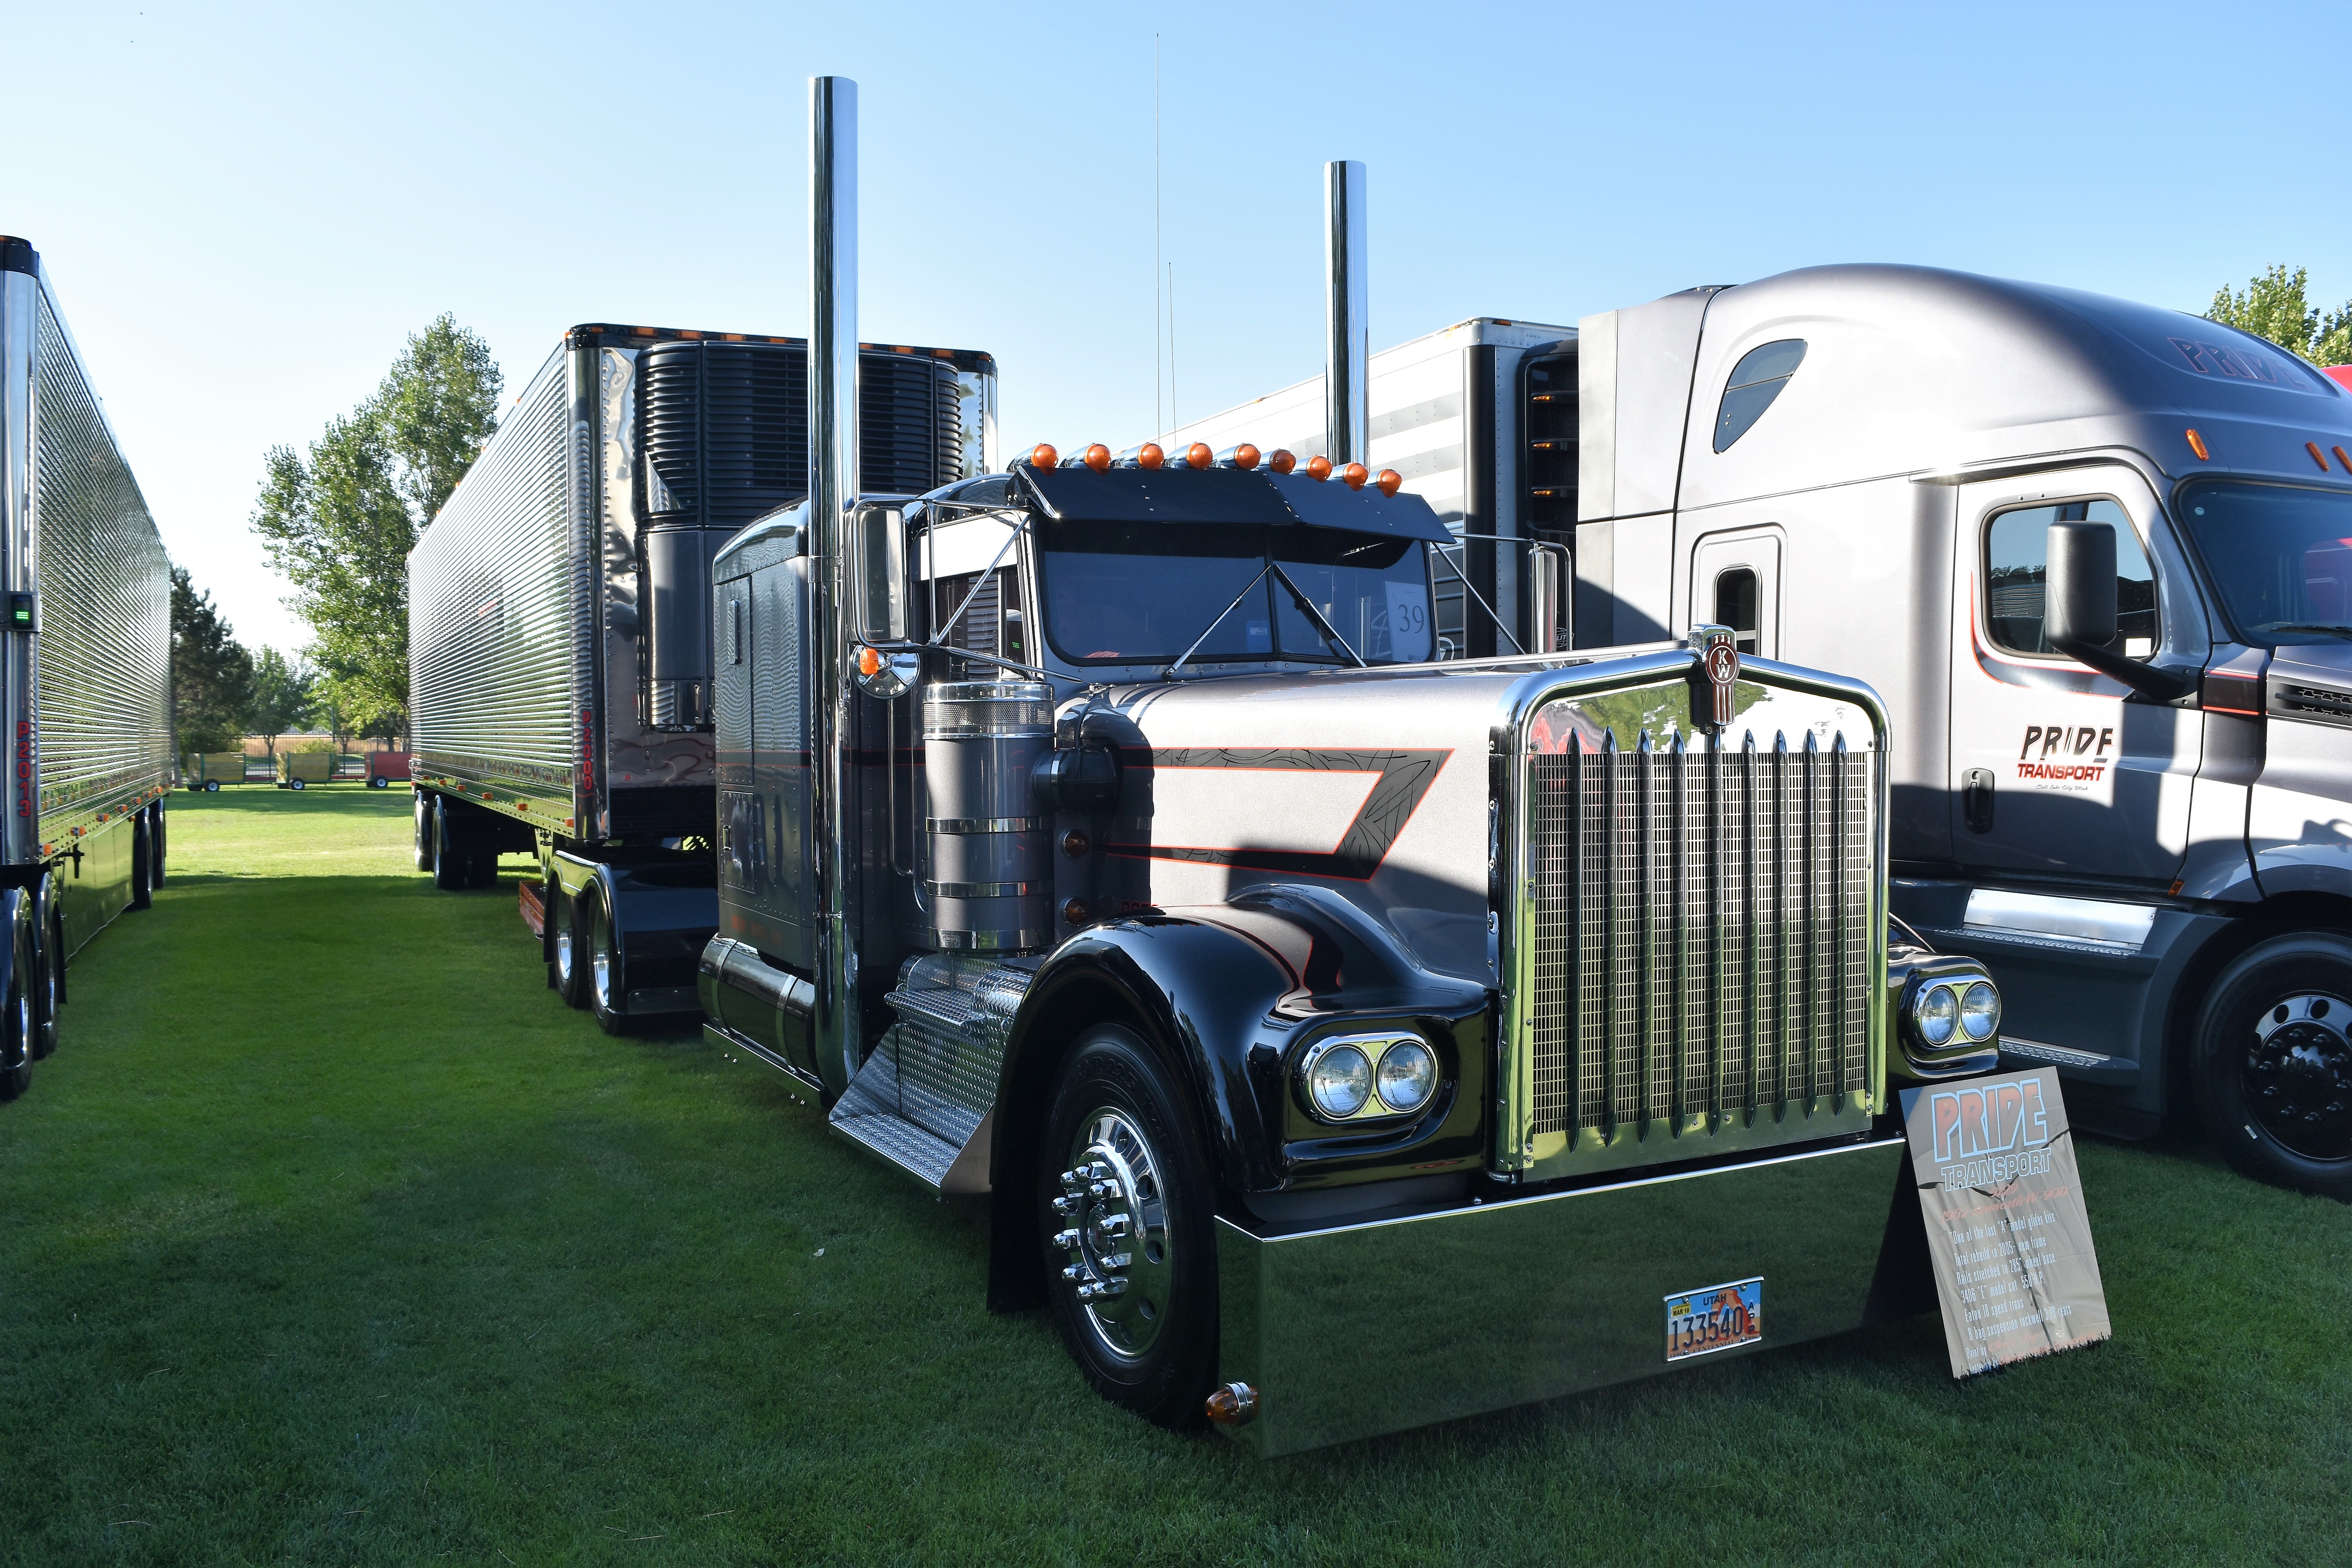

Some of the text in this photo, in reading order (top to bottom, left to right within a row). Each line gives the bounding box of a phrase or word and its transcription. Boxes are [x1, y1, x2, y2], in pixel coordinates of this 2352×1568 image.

[2167, 338, 2311, 391] PRIDE
[1397, 604, 1425, 633] 39
[582, 710, 593, 790] P2000
[2018, 724, 2115, 764] PRIDE
[17, 720, 31, 817] P2013
[2017, 763, 2105, 781] TRANSPORT
[1931, 1078, 2047, 1163] PRIDE
[1942, 1147, 2051, 1192] TRANSPORT
[1941, 1207, 1969, 1223] 1982
[1971, 1195, 2024, 1216] Kenworth
[1966, 1227, 1972, 1241] of
[1974, 1226, 1984, 1239] the
[1986, 1223, 1996, 1237] last
[2010, 1216, 2027, 1231] model
[2028, 1214, 2043, 1231] glider
[2044, 1211, 2056, 1223] kits
[1954, 1249, 1969, 1267] Total
[1971, 1244, 1990, 1263] rebuild
[1992, 1245, 1998, 1258] in
[2018, 1241, 2029, 1252] new
[2031, 1236, 2047, 1248] frame
[1956, 1267, 1972, 1285] Rails
[1973, 1261, 2000, 1280] stretched
[2002, 1262, 2008, 1274] to
[2024, 1256, 2041, 1269] wheel
[2043, 1252, 2056, 1264] base
[1703, 1293, 1726, 1306] UTAH
[1960, 1287, 1976, 1304] 3406
[1989, 1282, 2007, 1297] model
[2008, 1280, 2018, 1292] cat
[2020, 1274, 2033, 1289] 550
[1964, 1298, 2024, 1323] Eaton 18 speed trans
[1967, 1327, 1973, 1341] 8
[1974, 1324, 1985, 1341] bag
[1987, 1319, 2018, 1338] suspension
[2020, 1309, 2043, 1327] rockwell
[2058, 1305, 2072, 1317] rears
[1672, 1306, 1743, 1351] 133540
[1966, 1346, 1979, 1359] Paint
[1980, 1344, 1987, 1357] by
